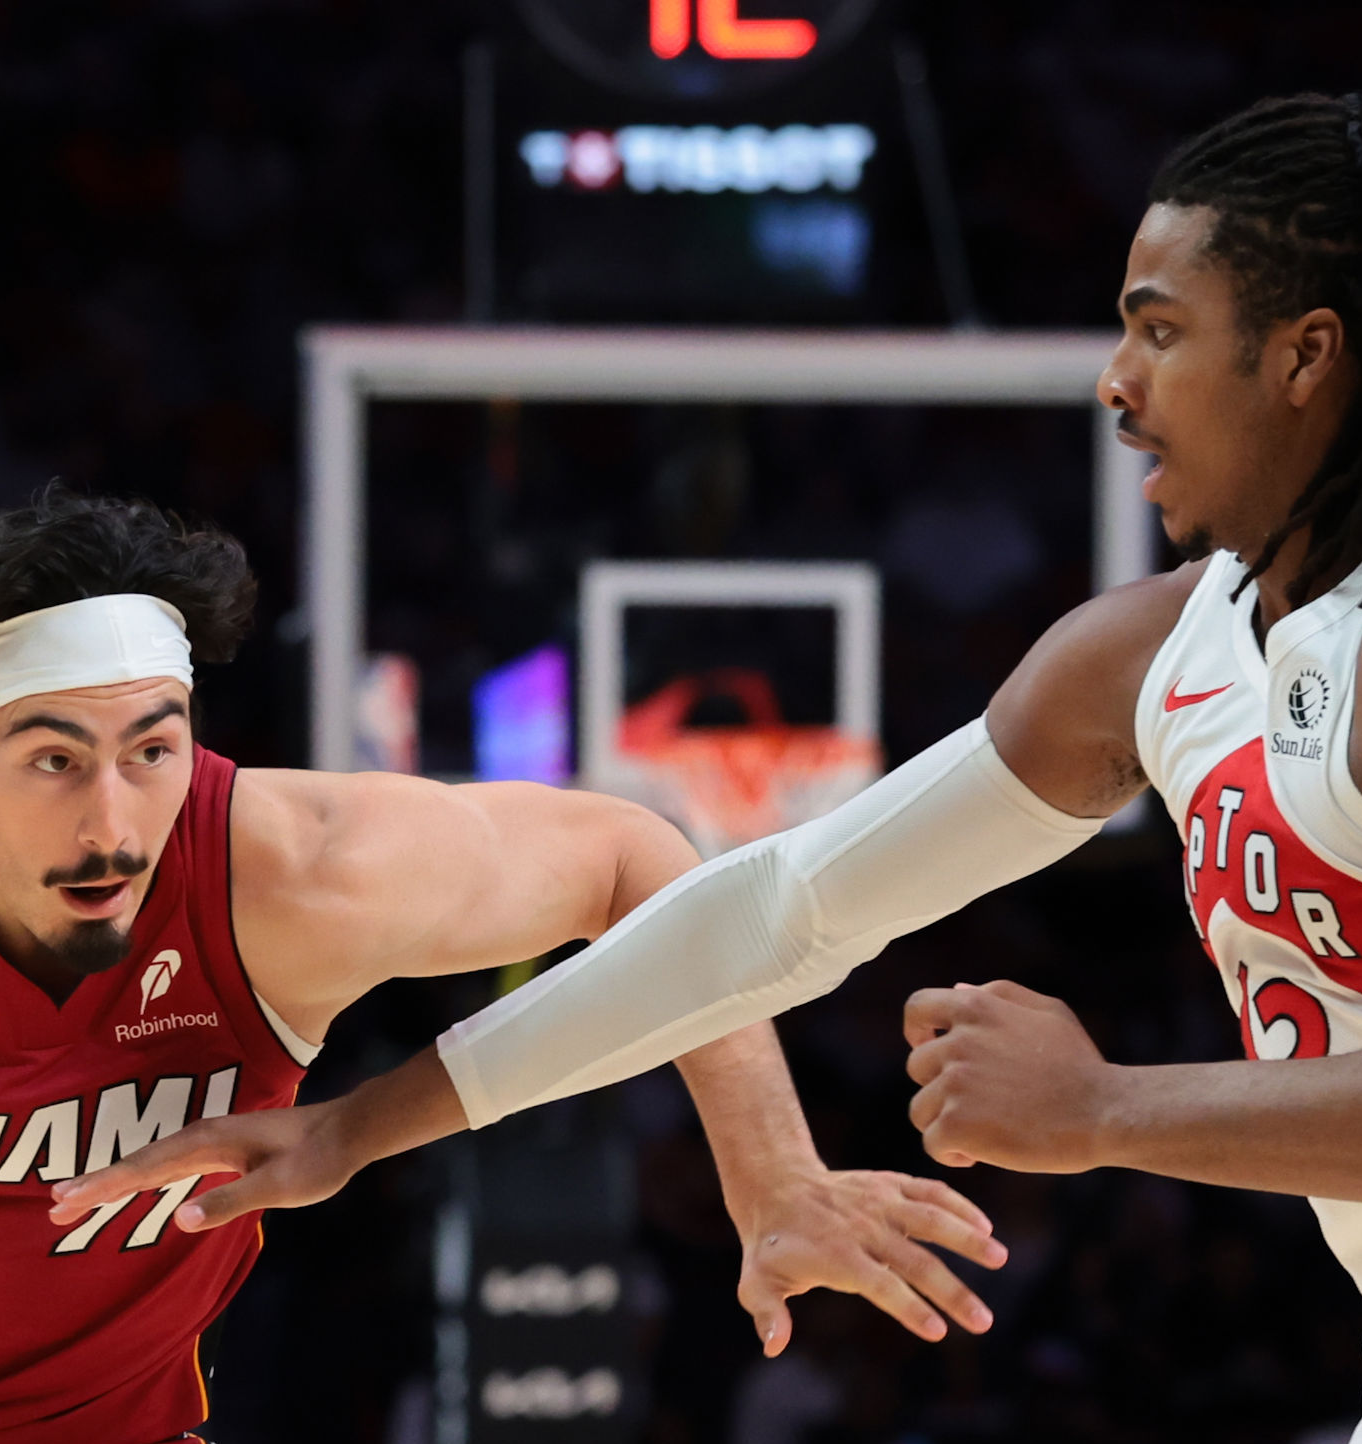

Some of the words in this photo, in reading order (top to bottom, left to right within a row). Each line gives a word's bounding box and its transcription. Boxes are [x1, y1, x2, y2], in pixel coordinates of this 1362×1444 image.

[1271, 732, 1298, 756] Sun
[1300, 737, 1323, 761] Life
[115, 1011, 218, 1043] Robinhood
